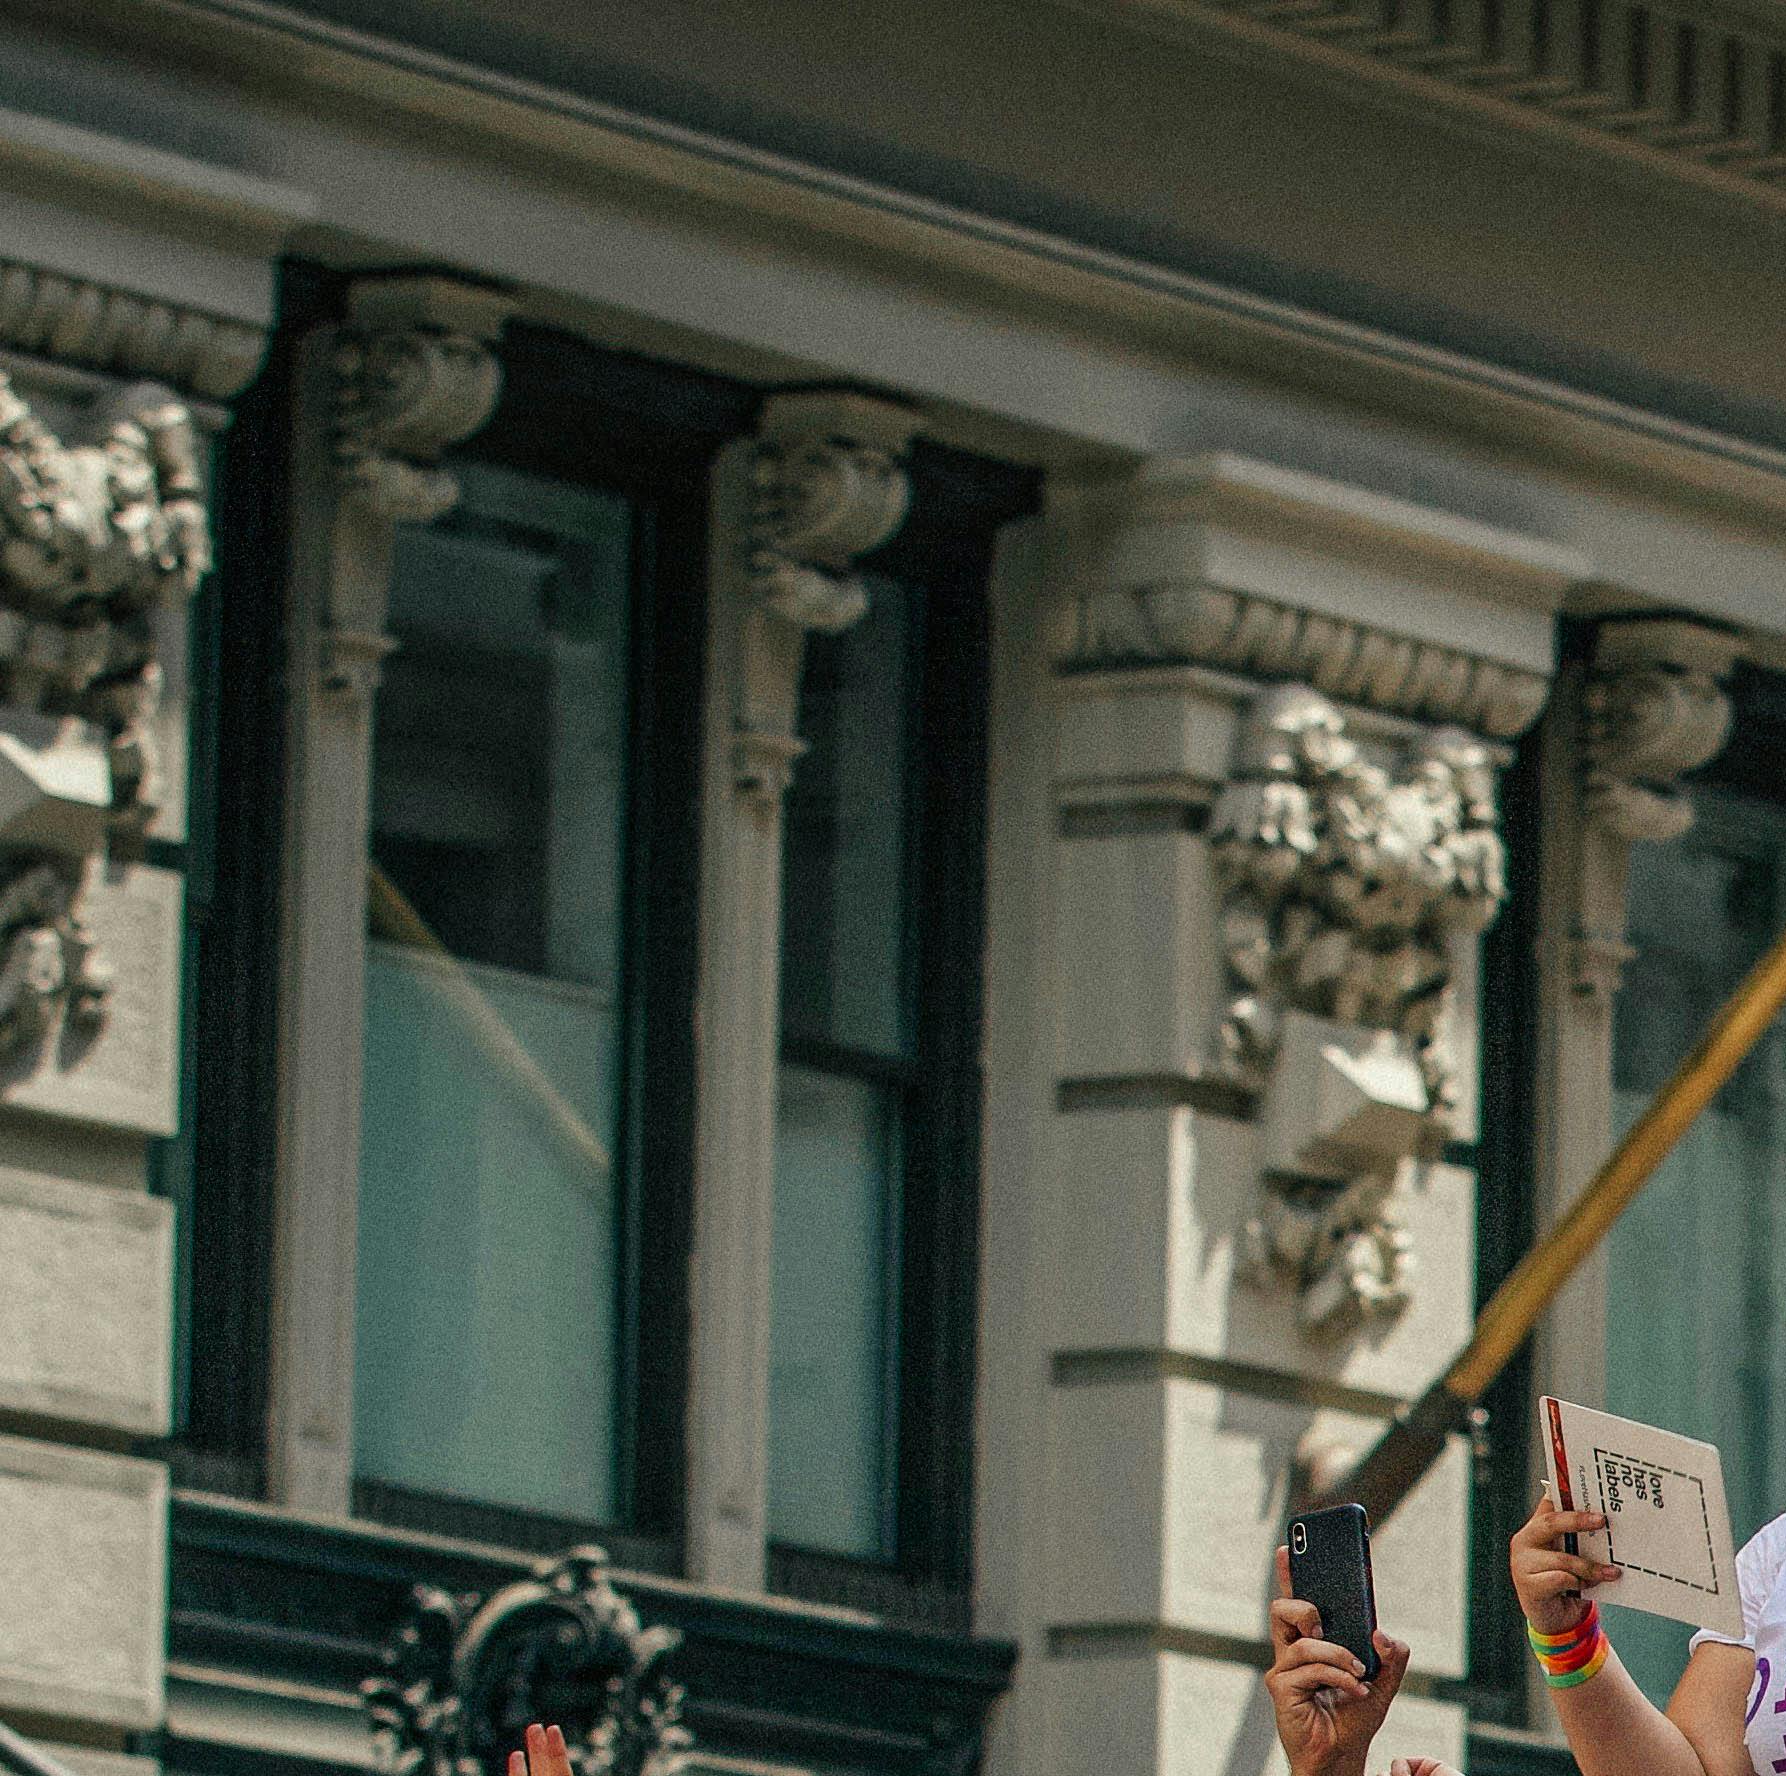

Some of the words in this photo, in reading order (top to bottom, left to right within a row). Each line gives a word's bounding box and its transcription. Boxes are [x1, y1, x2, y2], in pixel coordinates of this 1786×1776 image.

[1604, 1458, 1624, 1513] labels
[1620, 1463, 1634, 1487] no
[1633, 1467, 1648, 1501] has
[1649, 1470, 1665, 1509] love
